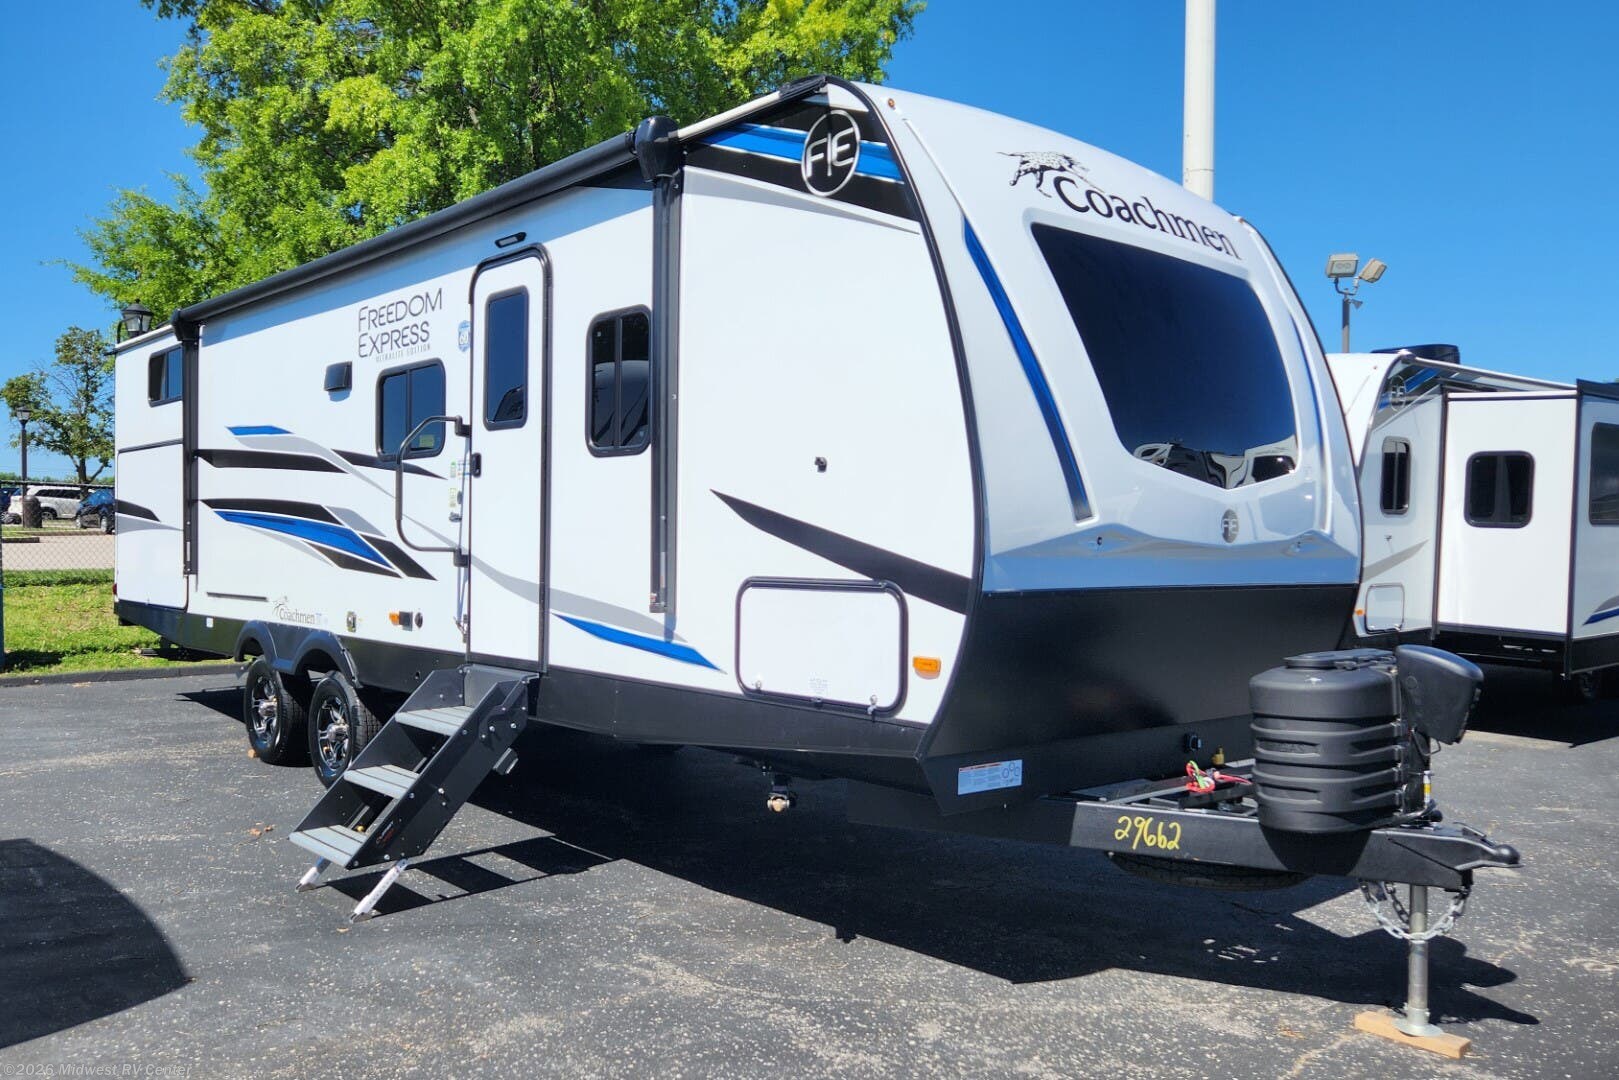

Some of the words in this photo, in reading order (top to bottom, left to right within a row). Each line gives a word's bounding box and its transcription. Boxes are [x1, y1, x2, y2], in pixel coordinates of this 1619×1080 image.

[1054, 175, 1240, 260] Coachmen
[358, 288, 442, 332] FREEDOM
[358, 320, 430, 358] EXPRESS
[279, 608, 315, 624] Coachmen
[1115, 816, 1181, 850] 29662
